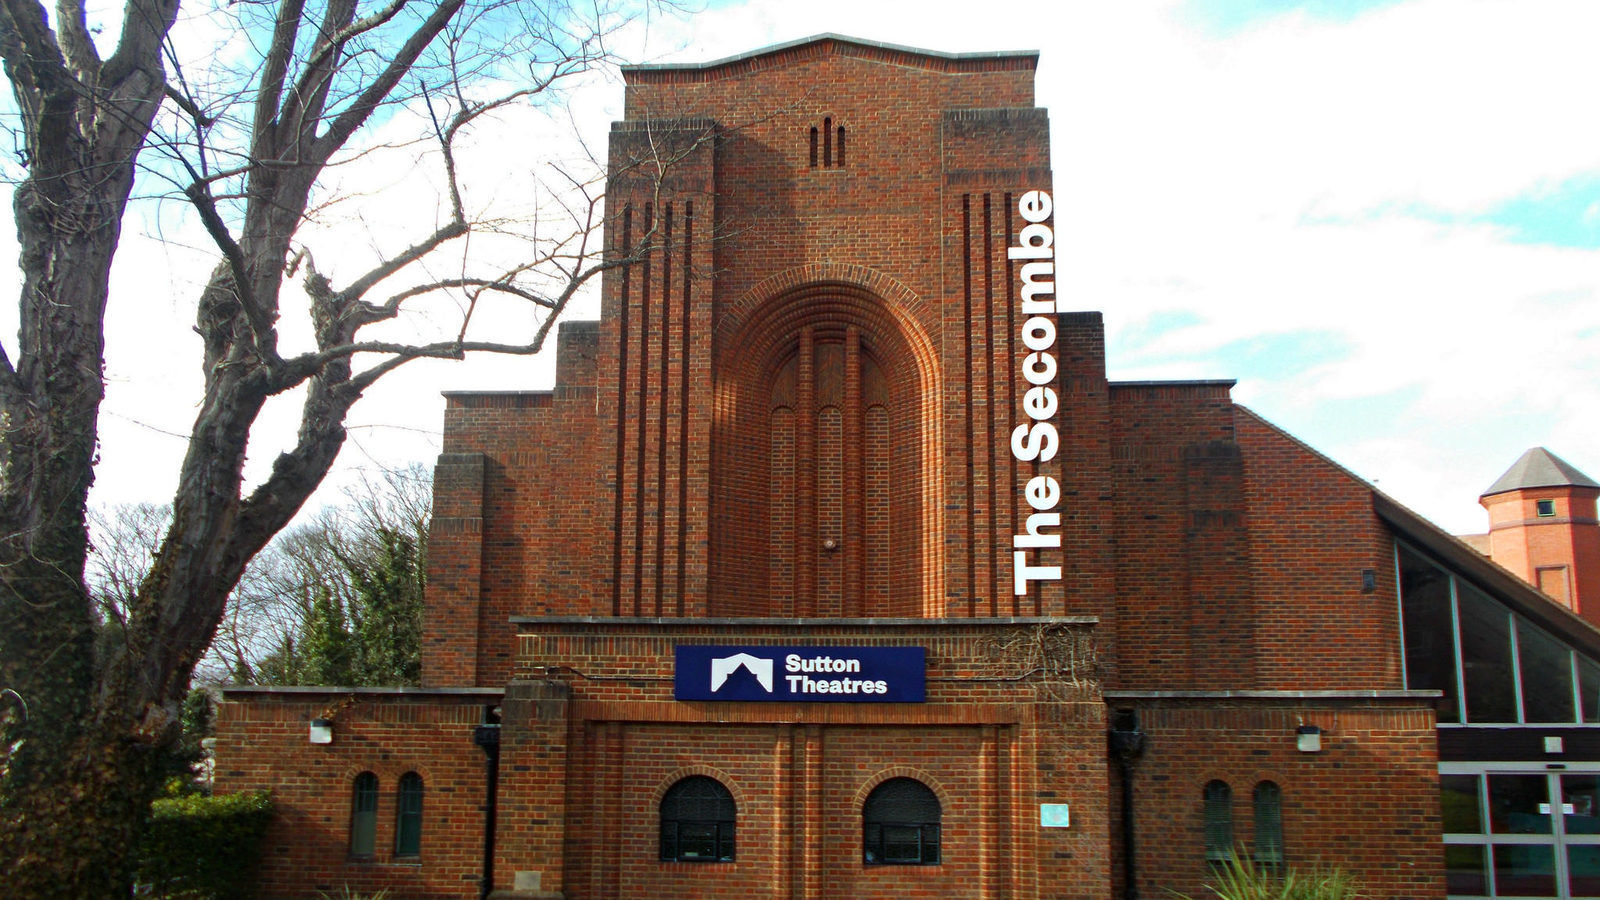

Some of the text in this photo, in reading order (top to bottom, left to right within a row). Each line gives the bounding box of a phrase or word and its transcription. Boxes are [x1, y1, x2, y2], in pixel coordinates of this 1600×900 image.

[1008, 190, 1062, 595] The Secombe
[785, 654, 860, 673] Sutton
[785, 675, 888, 694] Theatres
